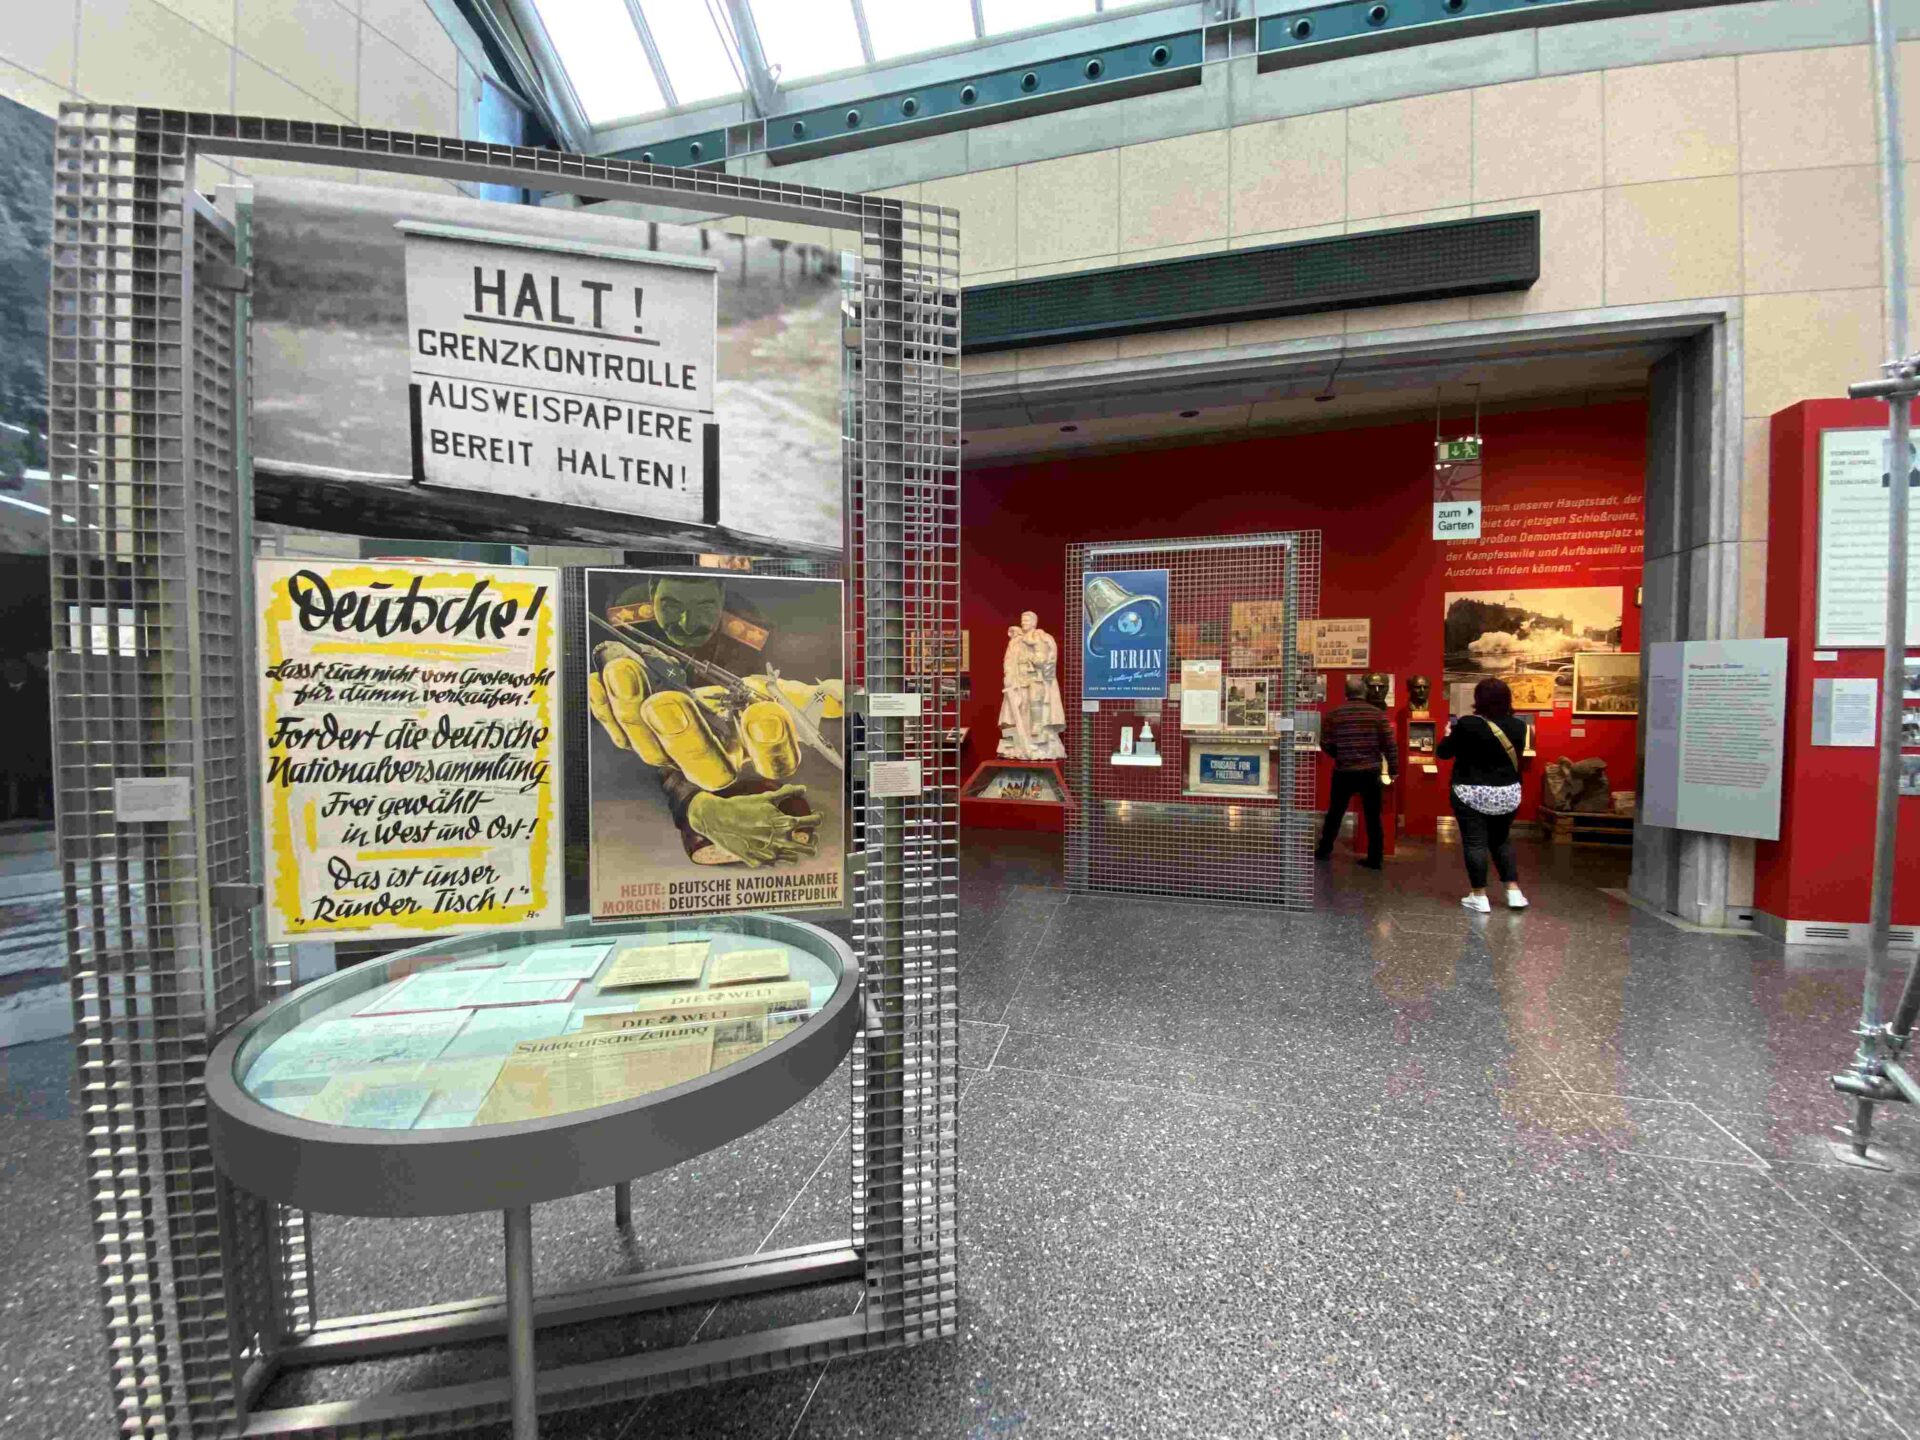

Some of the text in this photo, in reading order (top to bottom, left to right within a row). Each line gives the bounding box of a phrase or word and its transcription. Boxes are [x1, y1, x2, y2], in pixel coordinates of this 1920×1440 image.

[473, 267, 644, 334] HALT!
[418, 329, 697, 391] GRENZKONTROLLE
[429, 381, 693, 442] AUSWEISPAPIERE
[430, 429, 687, 491] BEREIT HALTEN!
[1438, 510, 1461, 518] zum
[1481, 504, 1510, 512] ntrum
[1513, 501, 1554, 510] unserer
[1623, 494, 1643, 504] der
[1438, 521, 1474, 531] Garten
[1481, 512, 1639, 528] biet der jetzigen Schloßruine,
[1479, 533, 1517, 546] großen
[1519, 528, 1632, 542] Demonstrationsplatz
[1446, 544, 1645, 561] der Kampfeswille und Aufbauwille un
[1444, 566, 1493, 577] Ausdruck
[1496, 565, 1529, 575] finden
[288, 569, 548, 639] Deutsche!
[1110, 649, 1162, 669] BERLIN
[265, 658, 556, 689] Lasst Euch nicht von Grotewohl
[294, 682, 536, 709] für dumm verkaufen!
[268, 713, 549, 750] Fordert die deutsche
[266, 752, 551, 794] Nationalversammlung
[1210, 759, 1251, 771] CRUSADE FOR
[321, 788, 494, 821] Frei gewählt
[341, 823, 370, 847] in
[374, 819, 436, 845] West
[436, 816, 482, 841] und
[327, 855, 500, 890] Das ist unser
[620, 872, 839, 898] HEUTE: DEUTSCHE NATIONALARMEE
[602, 886, 838, 914] MORGEN: DEUTSCHE SOWJETREPUBLIK
[671, 988, 773, 1005] DIE WELT
[622, 1010, 729, 1029] DIE WELT
